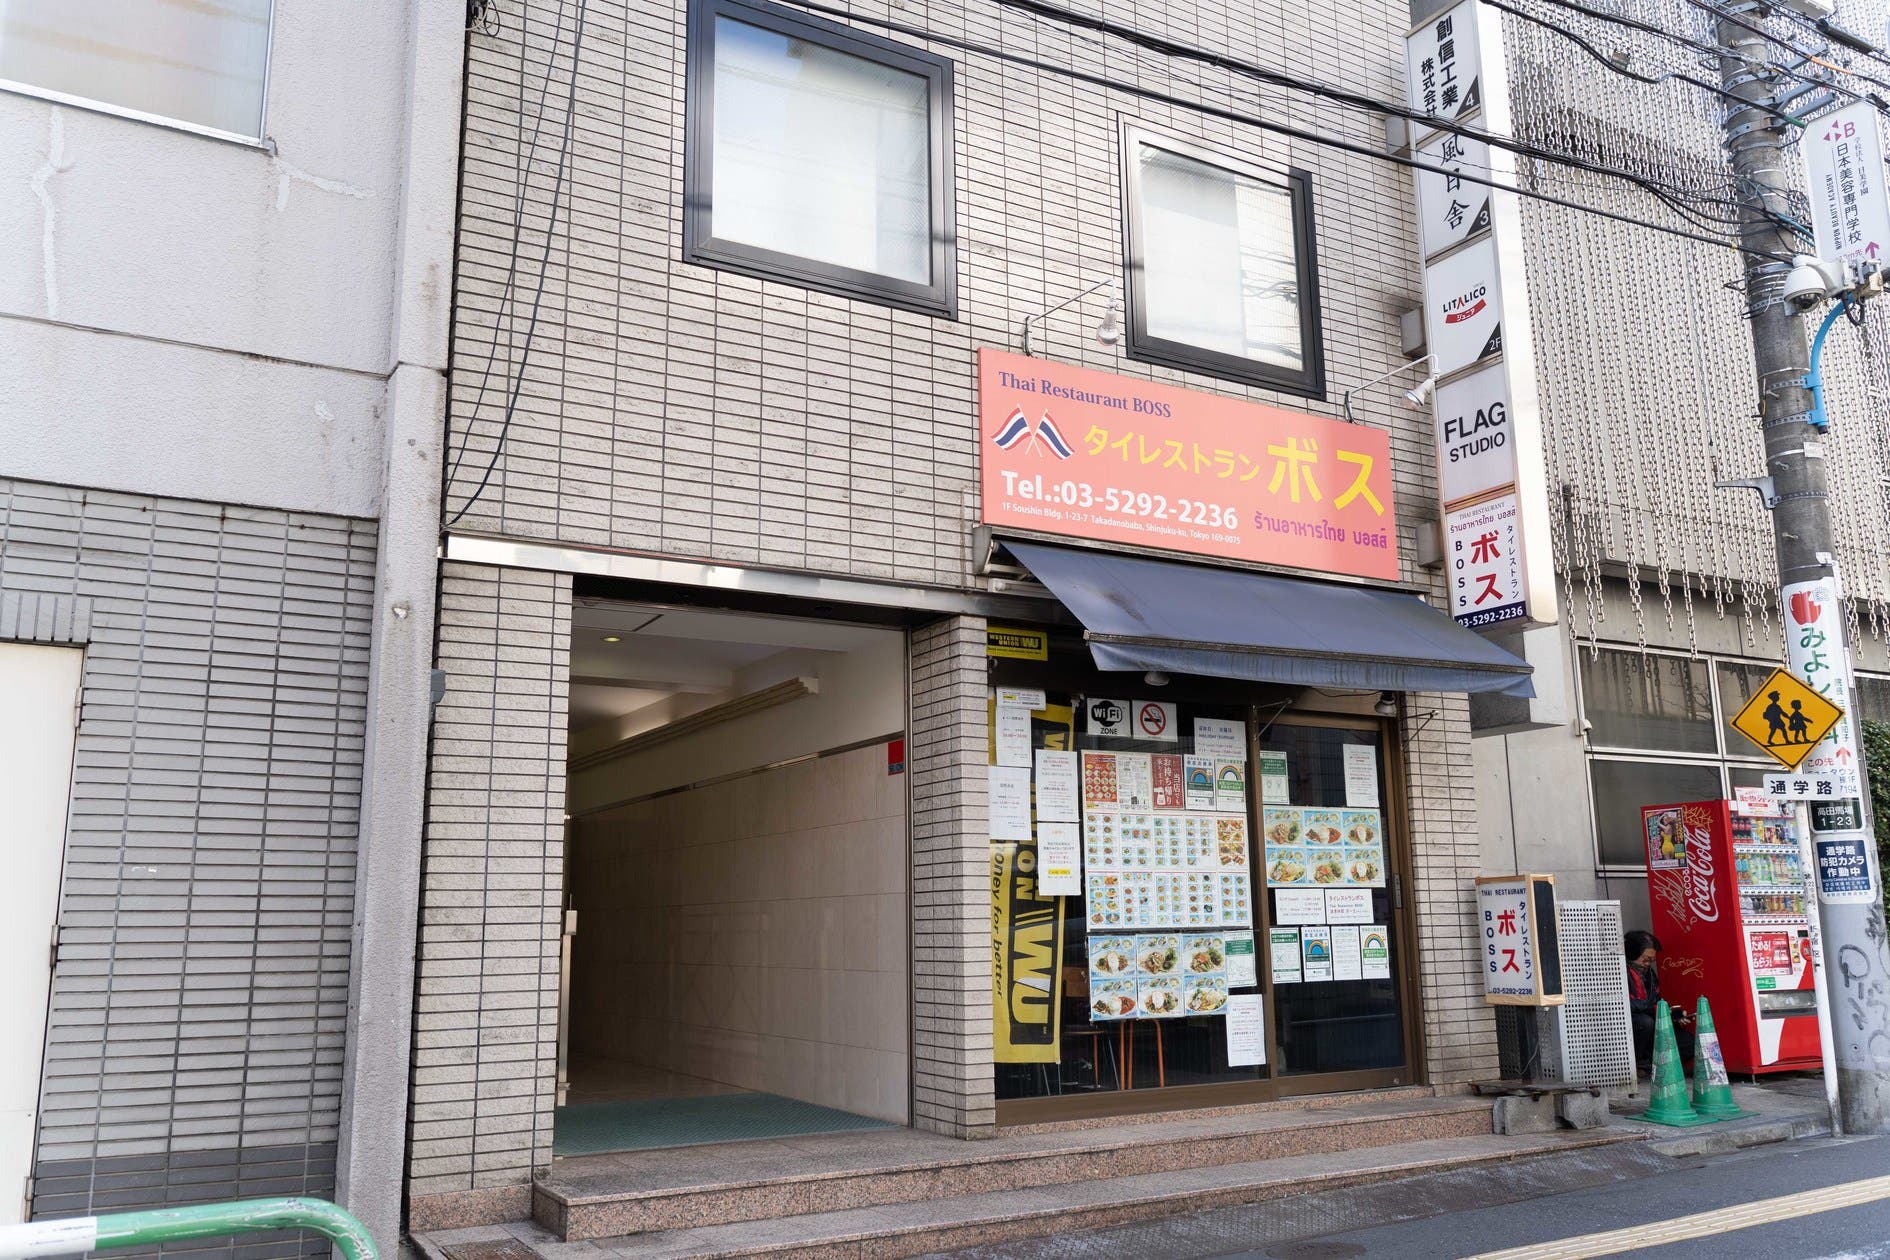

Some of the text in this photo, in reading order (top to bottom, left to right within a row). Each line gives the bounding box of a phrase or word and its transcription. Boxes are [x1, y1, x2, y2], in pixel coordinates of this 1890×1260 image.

[1436, 15, 1458, 110] 創信工業
[1843, 121, 1855, 139] B
[1825, 173, 1842, 250] NIPPON BEAUTY ACADEMY
[1443, 286, 1486, 313] LITALICO
[998, 371, 1172, 418] Thai Restaurant BOSS
[1444, 401, 1507, 444] FLAG
[1449, 431, 1506, 463] STUDIO
[1083, 424, 1385, 517] タイレストラン ボス
[1002, 502, 1241, 545] 1F Soushin Bldg. 1-23-7 Takadanobaba, Shinjuku-ku, Tokyo 169-0075
[1459, 501, 1505, 520] THAI RESTAURANT
[1471, 529, 1503, 606] ボス
[1507, 525, 1519, 600] タイレストラン
[1807, 757, 1834, 767] この先
[1770, 780, 1833, 795] 通学路
[1817, 806, 1854, 816] 高田馬場
[1821, 816, 1853, 827] 1-23
[1820, 855, 1865, 866] 防犯カメラ
[1826, 845, 1856, 856] 通学路
[1827, 867, 1861, 877] 作動中
[1495, 888, 1526, 896] RESTAURANT
[993, 905, 1002, 934] for
[1497, 909, 1520, 973] ボス
[1519, 901, 1532, 979] タイレストラン
[993, 938, 1003, 999] better
